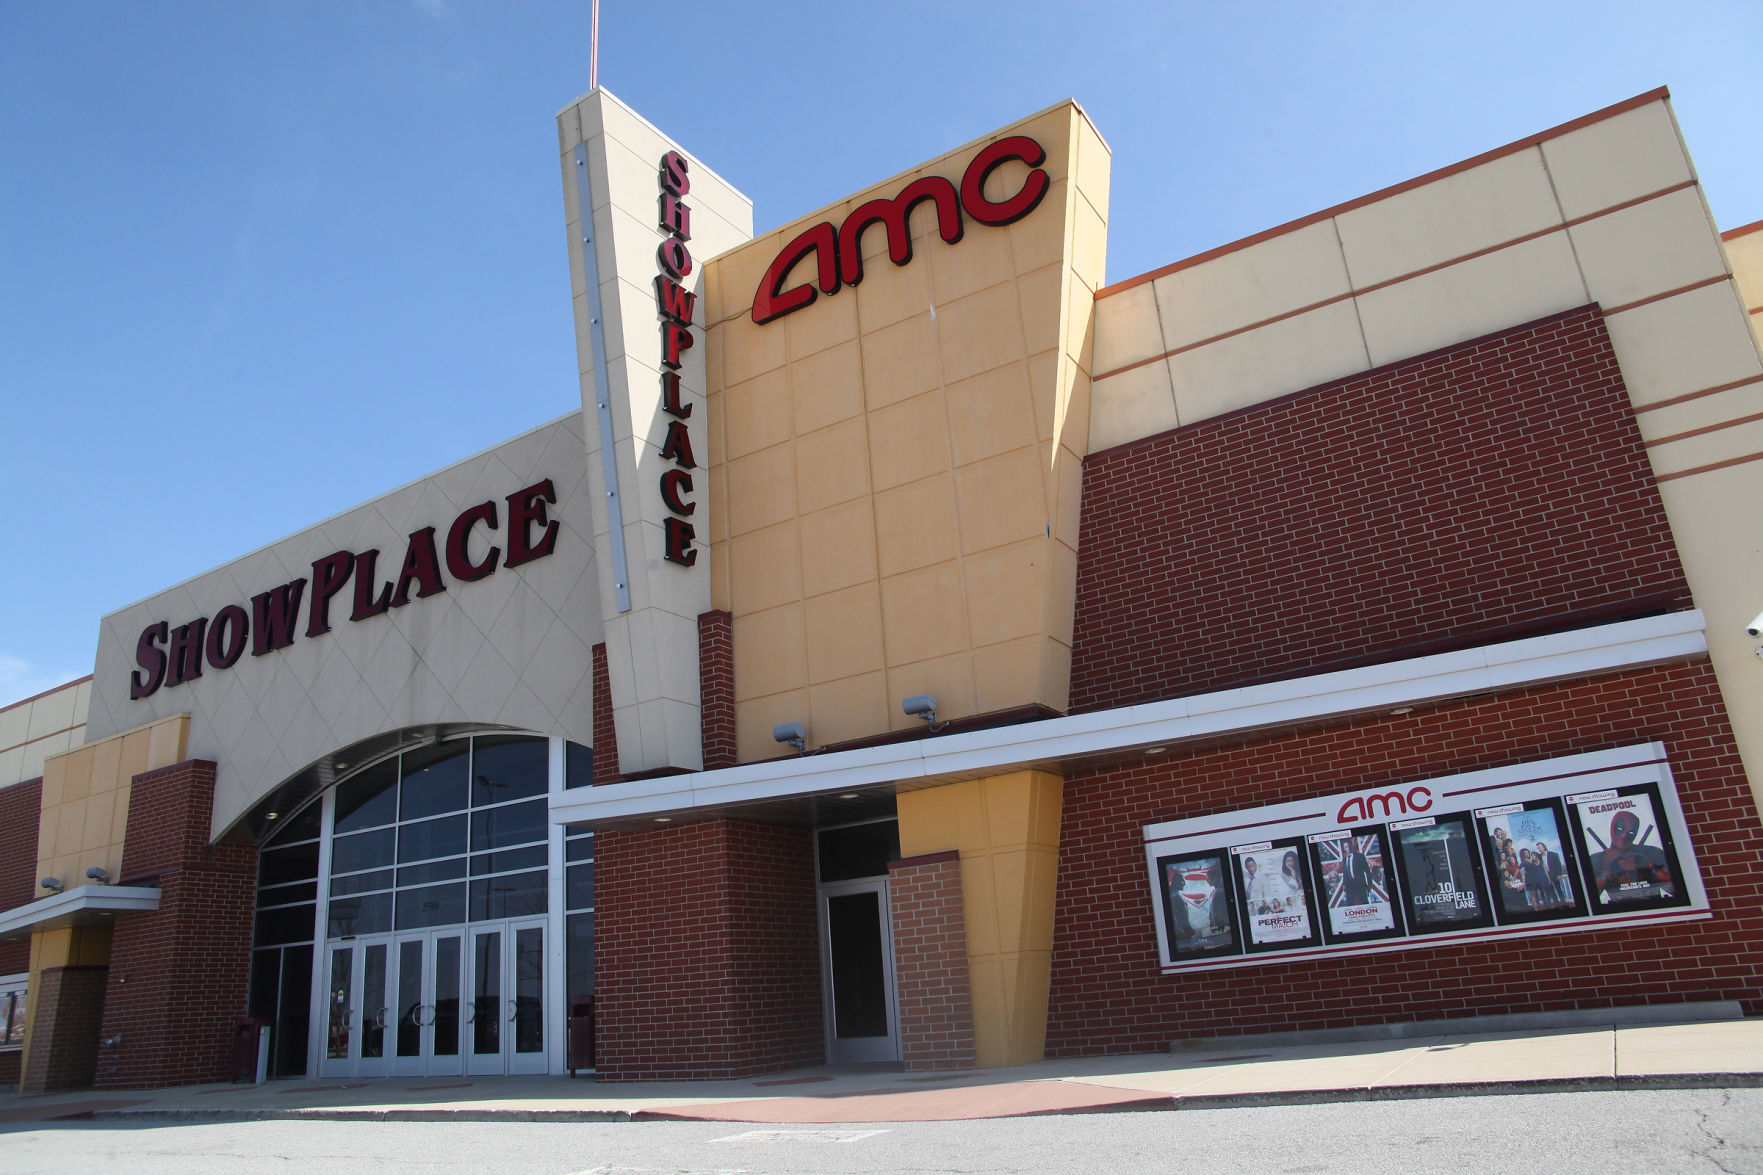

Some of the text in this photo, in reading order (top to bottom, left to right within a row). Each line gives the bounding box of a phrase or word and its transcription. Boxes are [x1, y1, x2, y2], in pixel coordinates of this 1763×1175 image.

[653, 150, 697, 568] SHOWPLACE
[130, 478, 560, 701] SHOWPLACE
[1588, 799, 1637, 815] DEADPOOL
[1437, 882, 1453, 894] 10
[1414, 891, 1475, 905] CLOVERFIELD
[1455, 900, 1477, 909] LANE
[1344, 906, 1378, 916] LONDON
[1257, 915, 1303, 926] PERFECT
